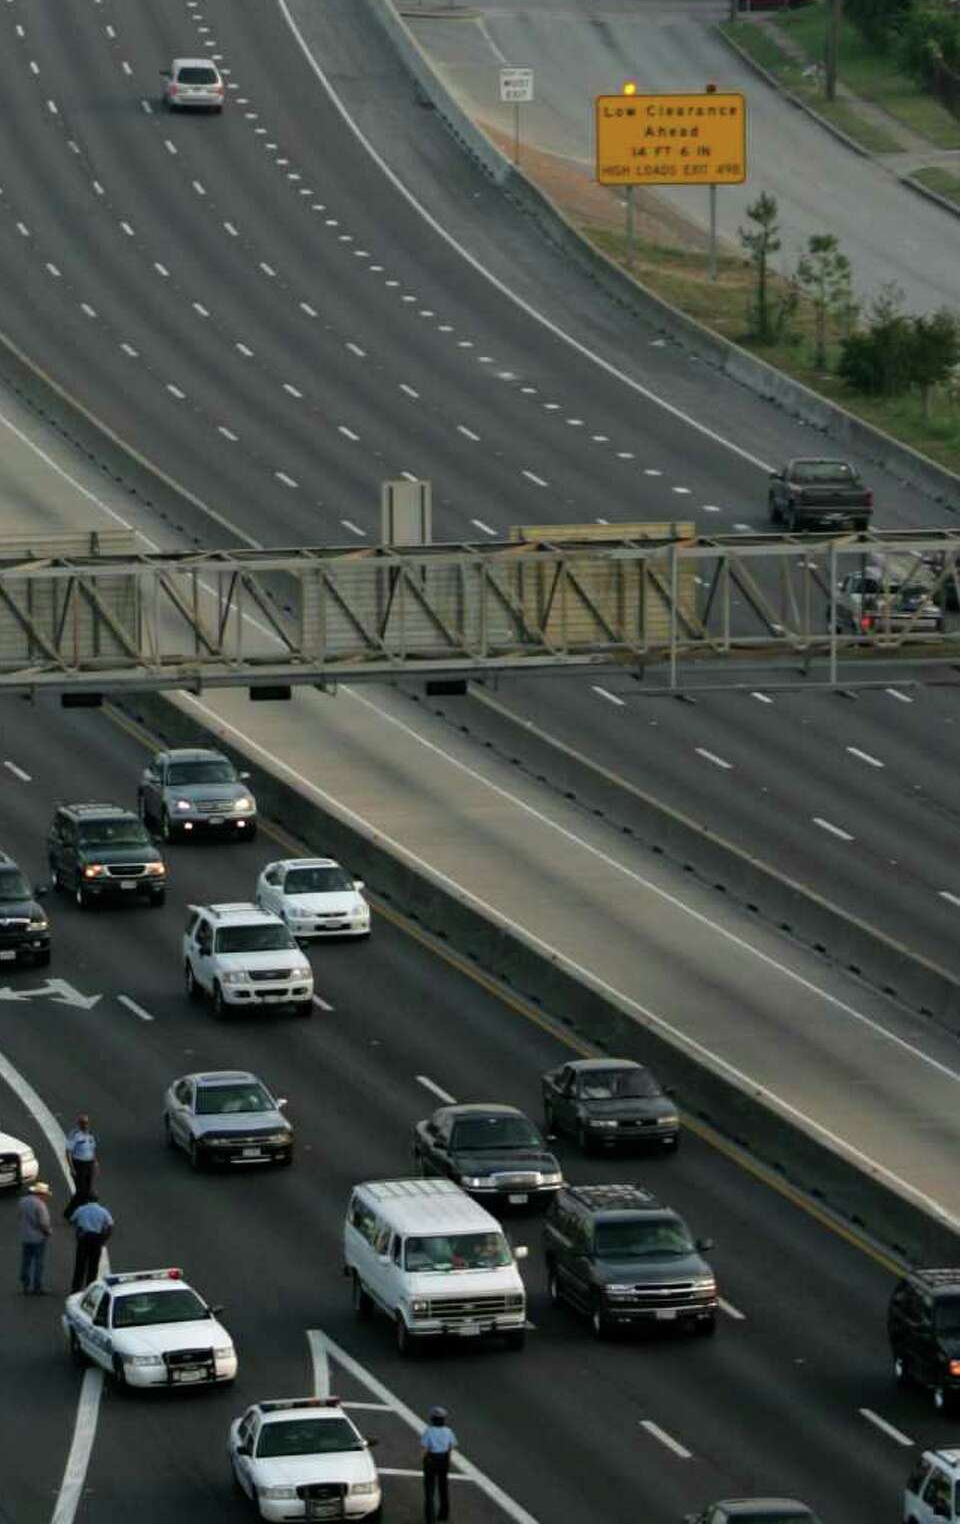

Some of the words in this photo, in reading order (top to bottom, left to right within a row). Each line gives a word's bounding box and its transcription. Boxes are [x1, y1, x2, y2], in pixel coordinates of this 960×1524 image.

[603, 106, 636, 118] Low
[646, 104, 737, 117] Clearance
[644, 126, 700, 138] Ahead
[632, 146, 646, 157] 14
[654, 146, 672, 157] FT
[680, 145, 689, 156] 6
[697, 145, 711, 156] IN
[602, 165, 631, 176] HIGH
[636, 164, 677, 176] LOADS
[684, 164, 708, 175] EXIT
